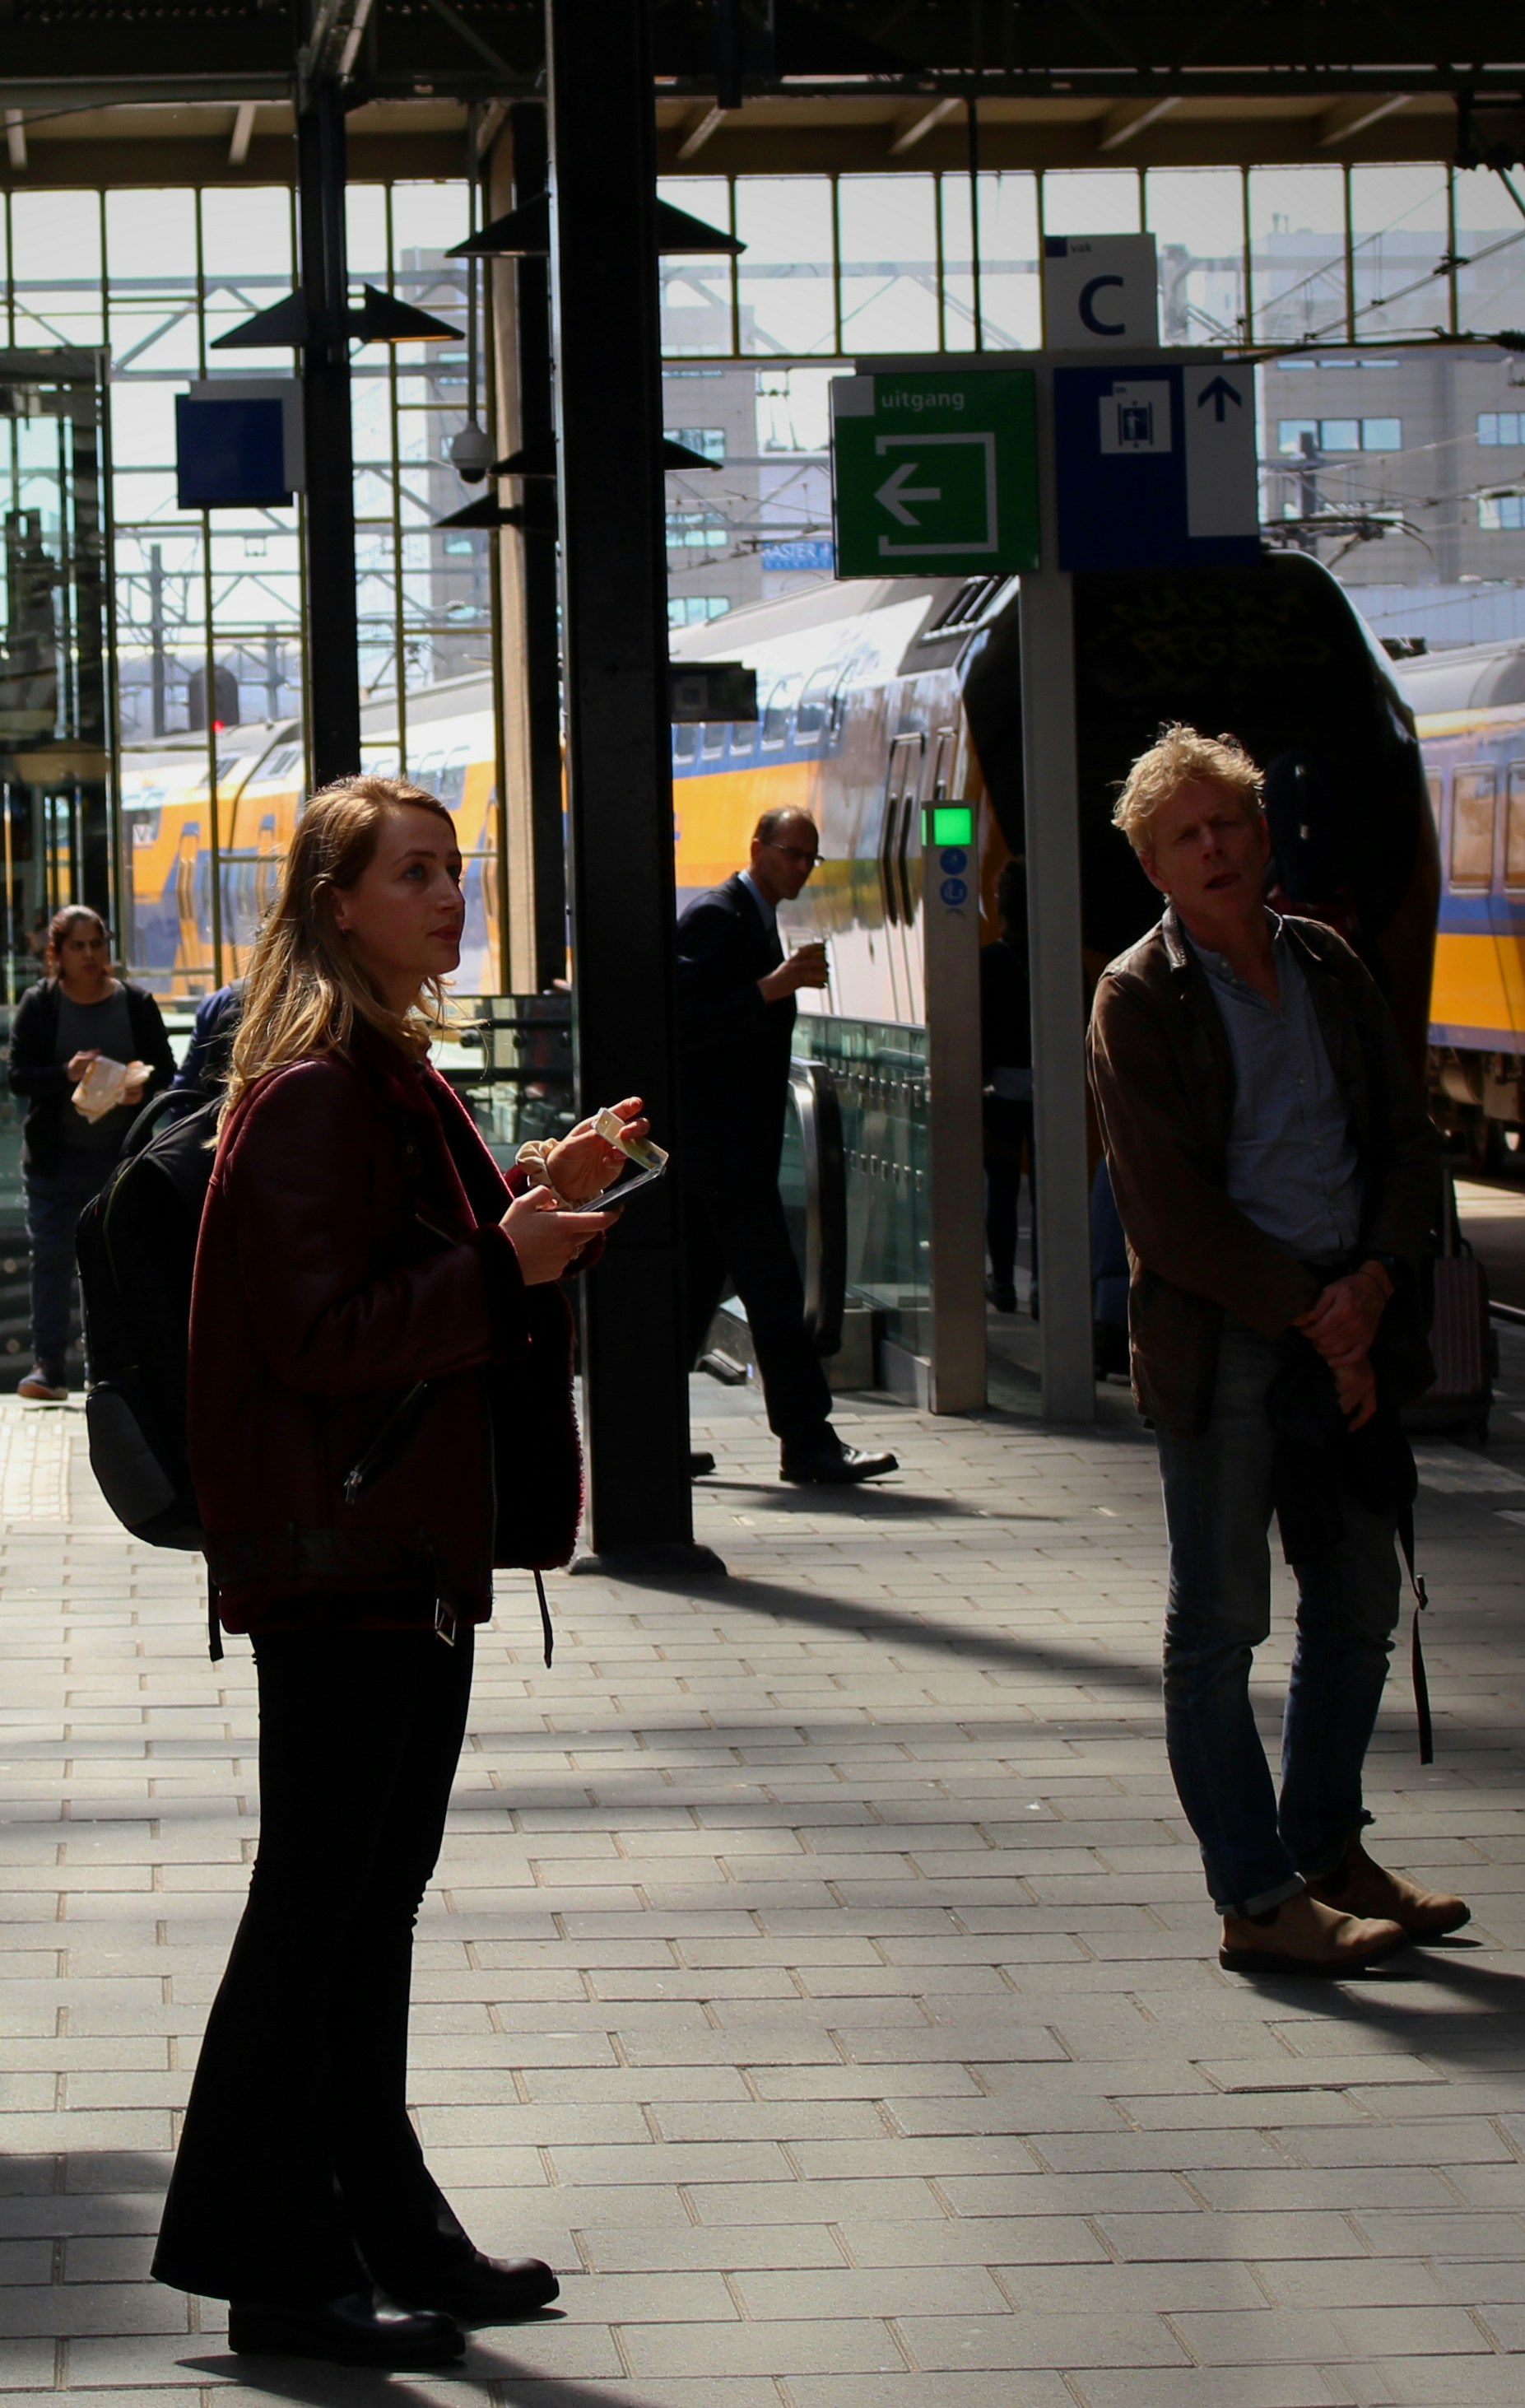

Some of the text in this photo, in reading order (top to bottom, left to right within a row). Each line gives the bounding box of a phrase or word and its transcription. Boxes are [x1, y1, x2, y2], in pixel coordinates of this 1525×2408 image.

[1071, 242, 1092, 253] vak
[1080, 276, 1126, 336] C
[881, 390, 965, 412] uitgang
